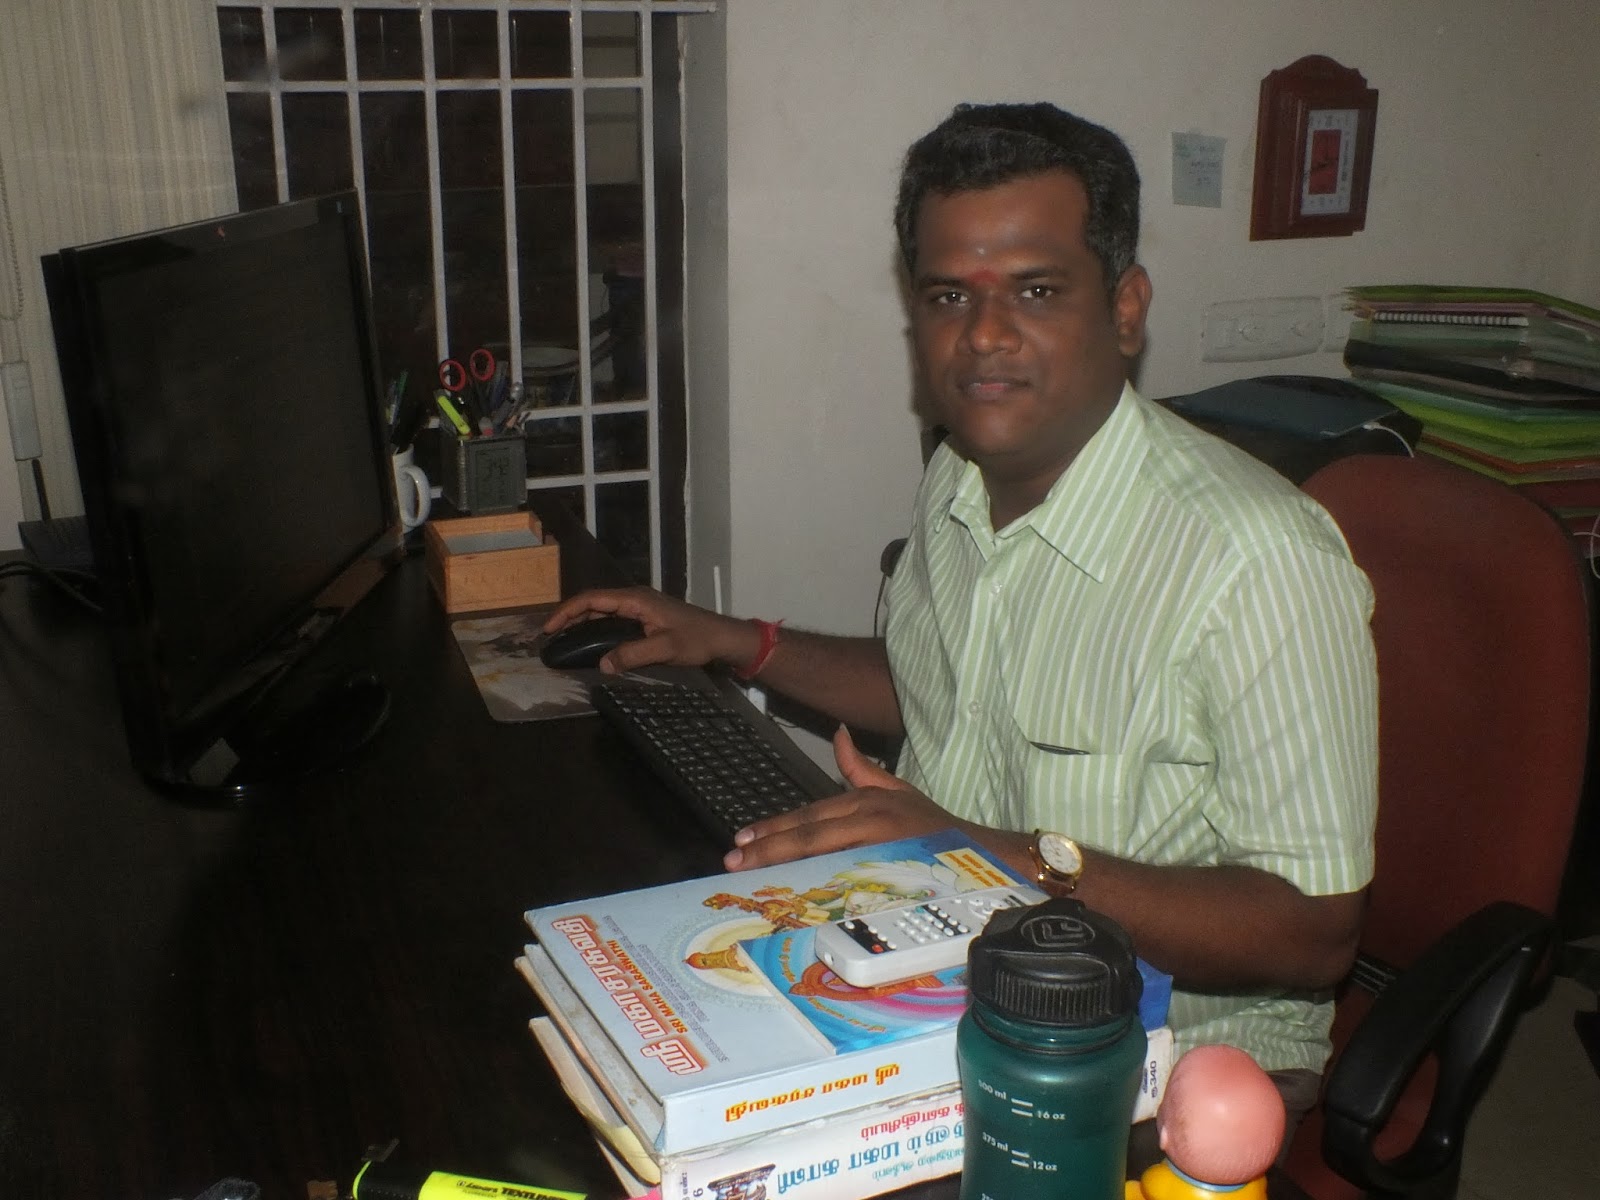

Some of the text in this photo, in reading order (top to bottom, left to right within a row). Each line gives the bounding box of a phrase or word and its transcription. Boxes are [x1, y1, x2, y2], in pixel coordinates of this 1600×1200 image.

[605, 939, 689, 1034] SRI MAHA SARASWATHI
[610, 992, 669, 1040] மகா
[821, 1072, 868, 1095] மகா
[994, 1089, 1007, 1100] ml
[1037, 1110, 1066, 1120] 16 oz
[997, 1142, 1009, 1152] ml
[848, 1141, 901, 1171] மகா
[1032, 1160, 1058, 1171] 12 oz
